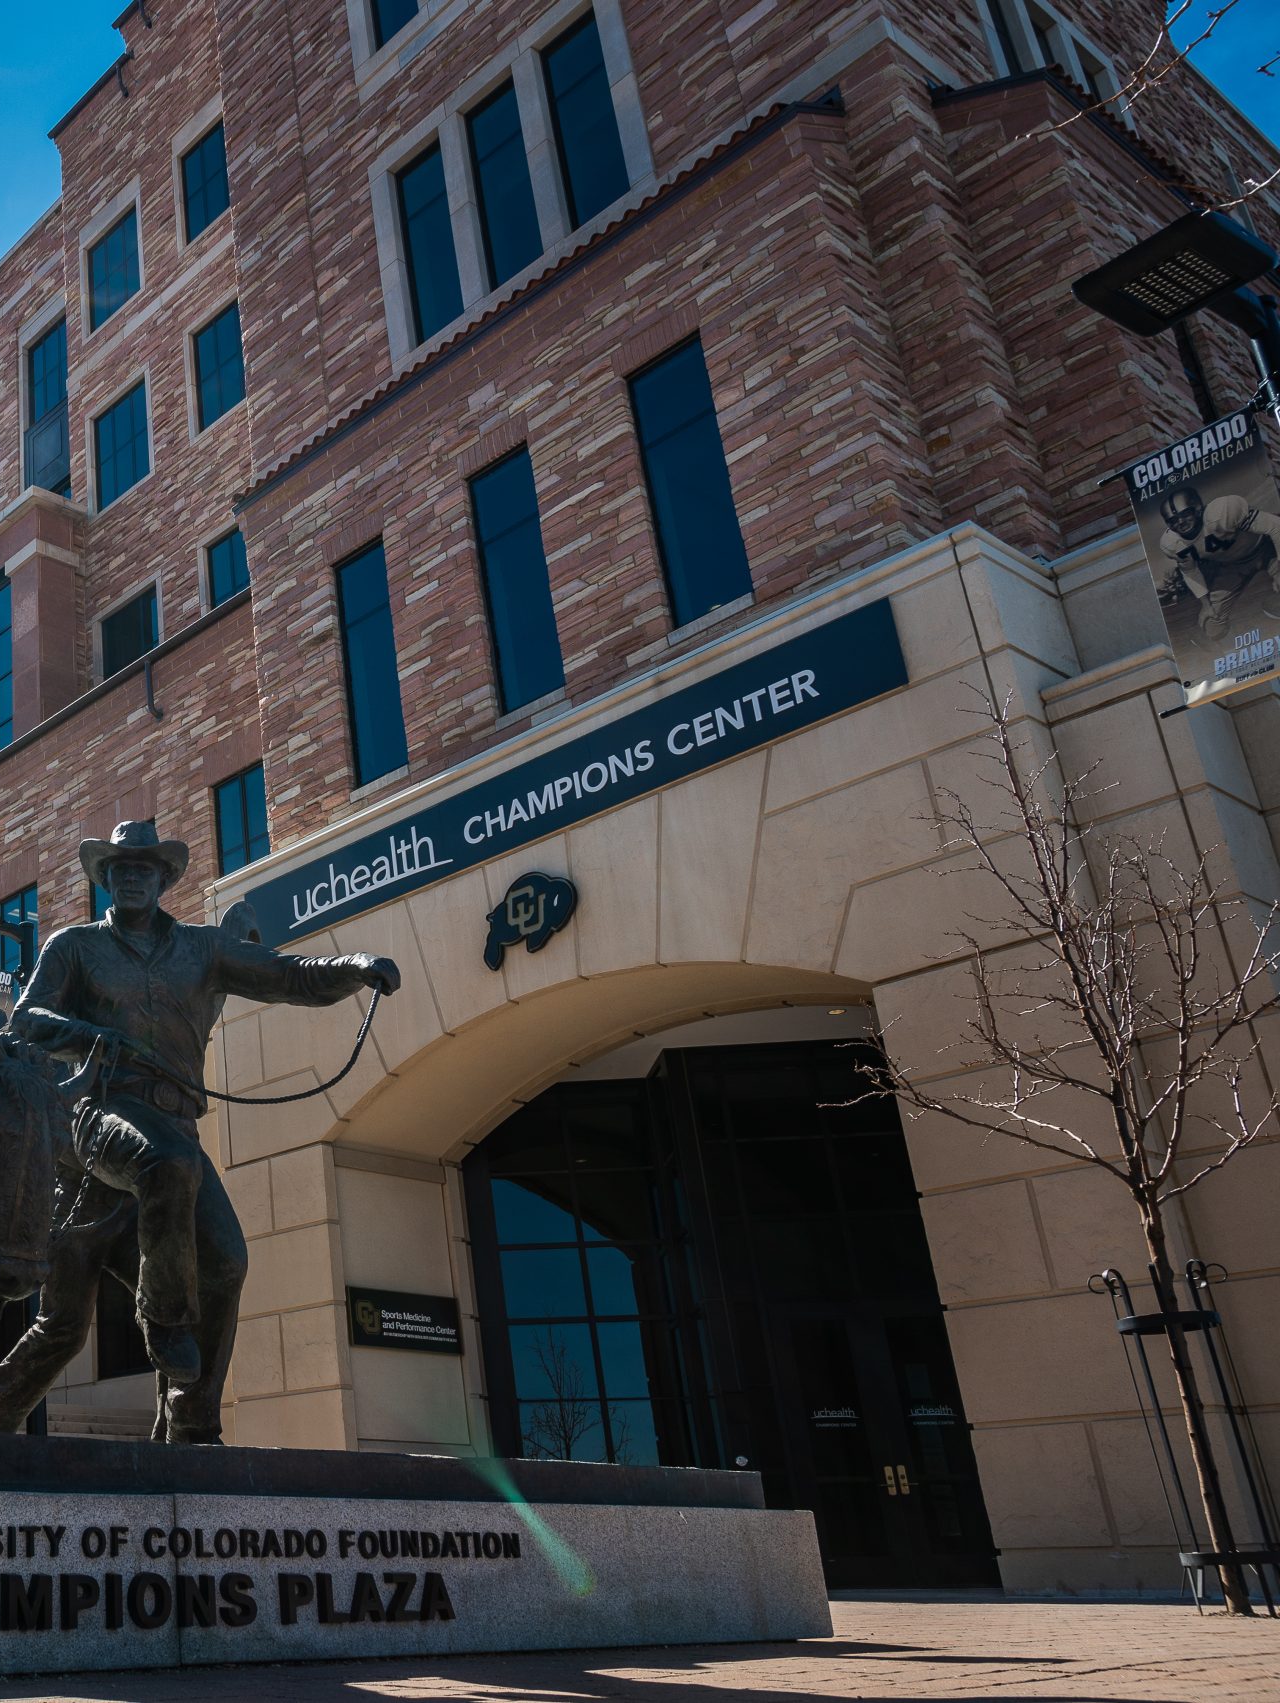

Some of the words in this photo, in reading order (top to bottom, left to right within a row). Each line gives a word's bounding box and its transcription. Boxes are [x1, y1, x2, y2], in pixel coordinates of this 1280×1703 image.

[1132, 414, 1248, 489] COLORADO
[1140, 482, 1165, 502] ALL
[1181, 433, 1254, 481] AMERICAN
[1234, 628, 1260, 650] DON
[291, 826, 437, 924] uchealth
[463, 739, 655, 845] CHAMPIONS
[666, 669, 820, 755] CENTER
[381, 1309, 402, 1320] Sports
[403, 1312, 431, 1322] Medicine
[382, 1321, 394, 1329] and
[396, 1322, 435, 1333] Performance
[436, 1326, 456, 1335] Center
[813, 1407, 856, 1418] uchealth
[910, 1404, 953, 1415] uchealth
[81, 1526, 129, 1559] OF
[143, 1526, 328, 1559] COLORADO
[338, 1529, 520, 1560] FOUNDATION
[277, 1571, 457, 1626] PLAZA
